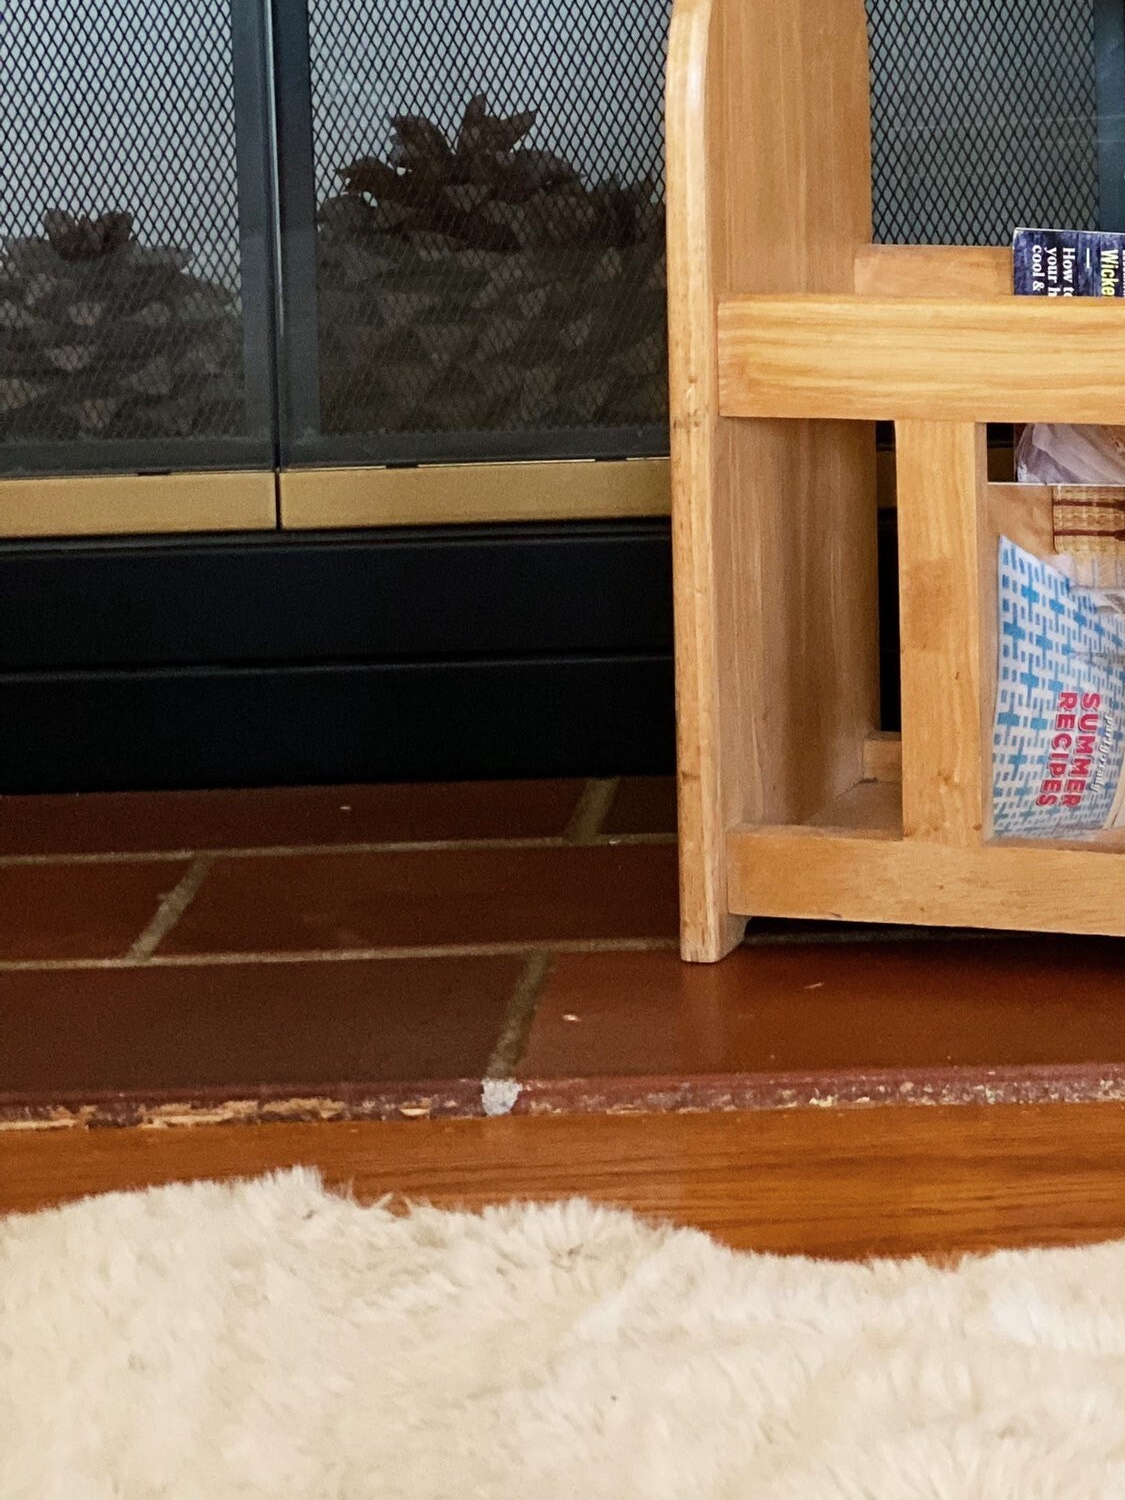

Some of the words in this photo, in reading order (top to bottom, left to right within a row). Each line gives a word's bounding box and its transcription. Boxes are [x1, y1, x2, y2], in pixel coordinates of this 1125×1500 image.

[1031, 244, 1046, 277] cool
[1044, 246, 1058, 283] your
[1062, 247, 1076, 283] How
[1032, 280, 1046, 292] &
[1035, 691, 1079, 807] RECIPES
[1060, 691, 1103, 808] SUMMER
